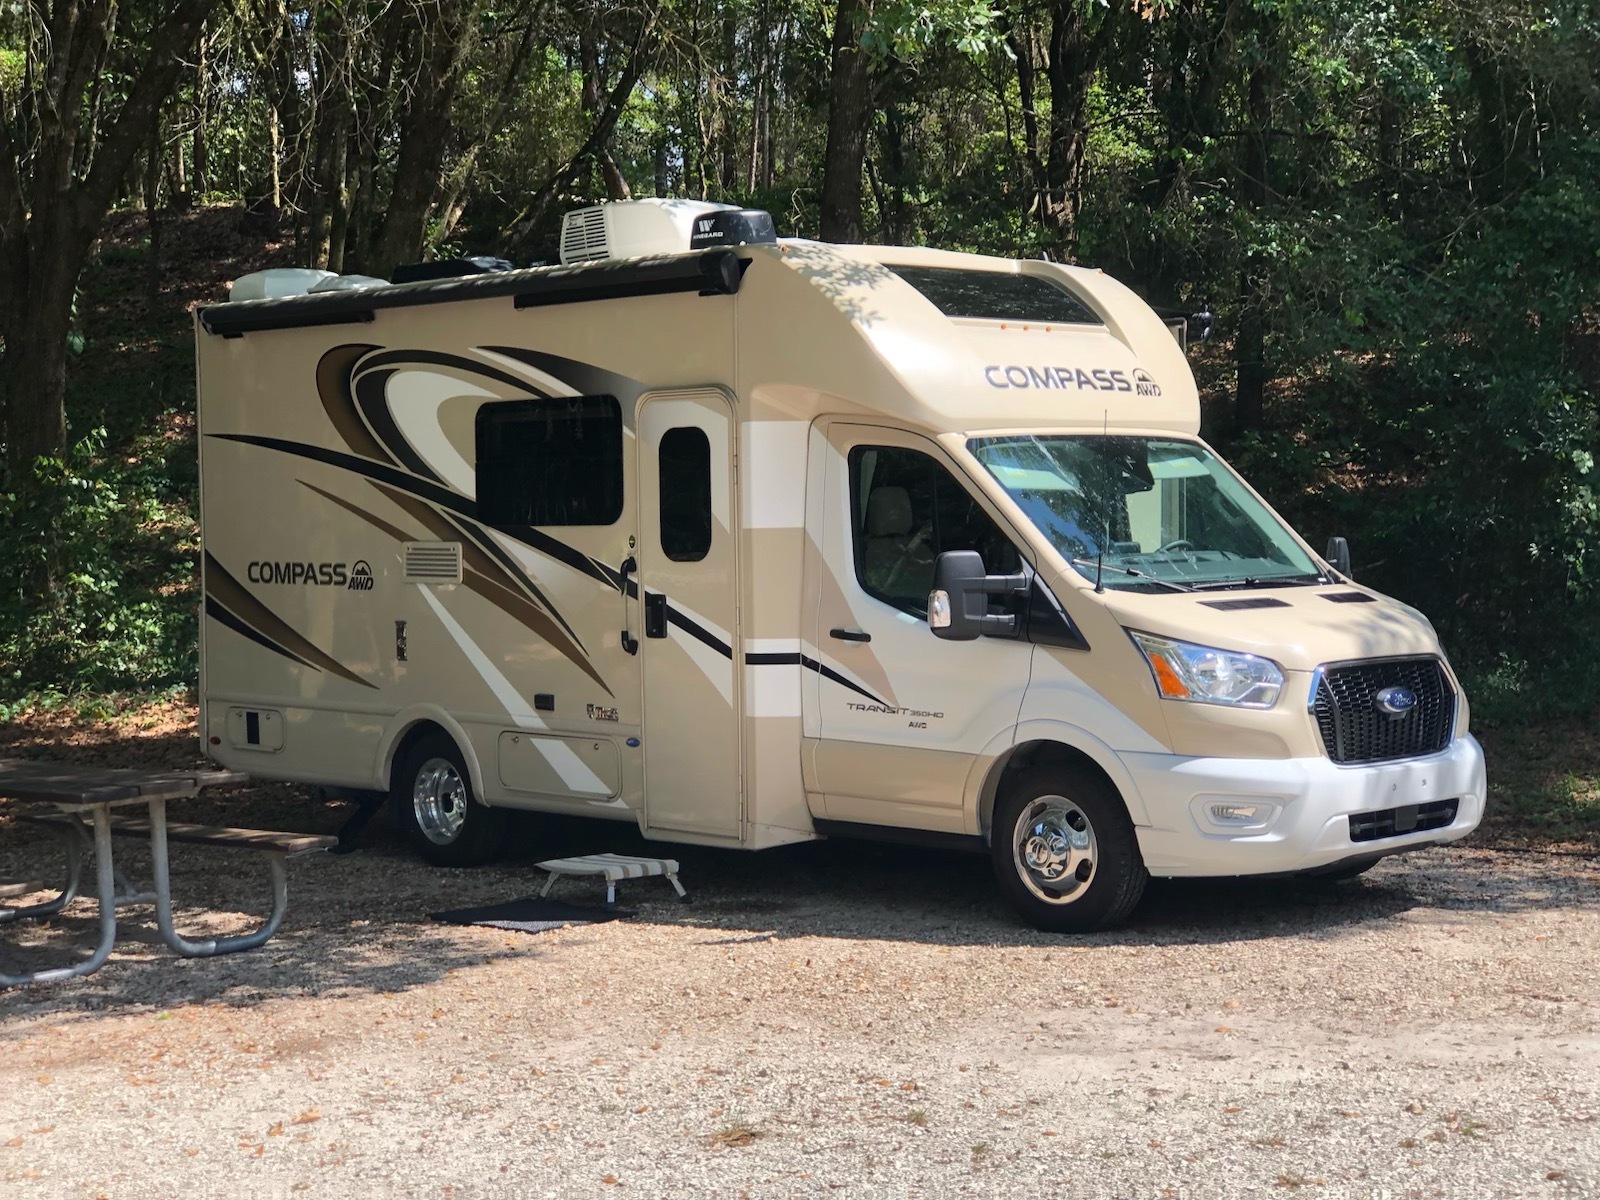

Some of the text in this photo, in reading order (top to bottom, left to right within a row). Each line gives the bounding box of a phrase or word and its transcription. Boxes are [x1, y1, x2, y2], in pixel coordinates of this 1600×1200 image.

[984, 365, 1132, 392] COMPASS
[1136, 383, 1162, 397] AWD
[247, 561, 347, 586] COMPASS
[347, 576, 374, 591] AWD
[846, 702, 909, 716] TRANSIT
